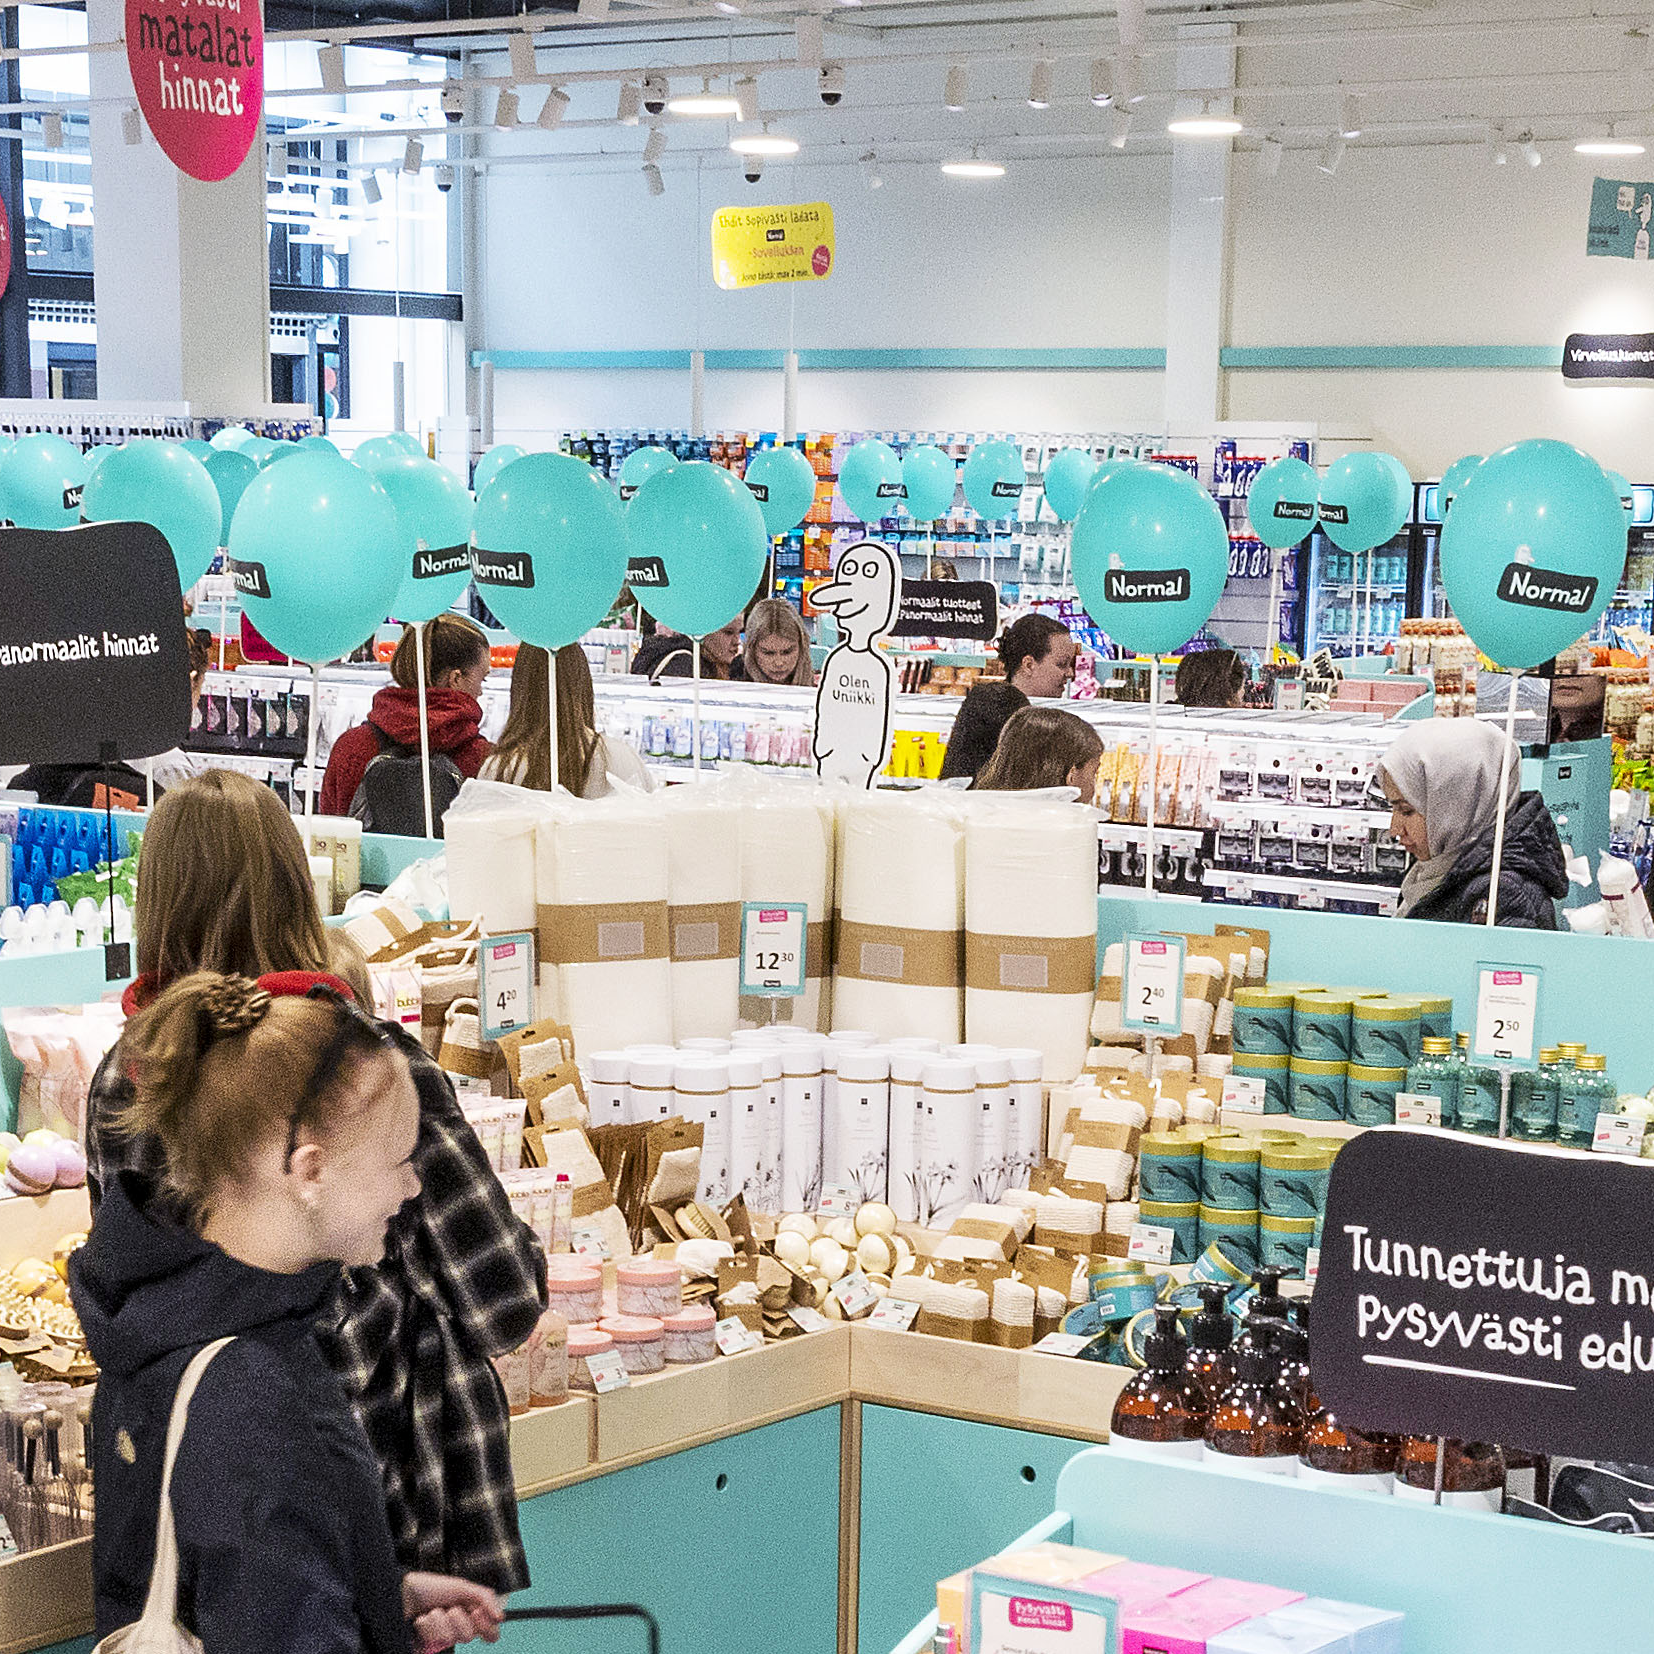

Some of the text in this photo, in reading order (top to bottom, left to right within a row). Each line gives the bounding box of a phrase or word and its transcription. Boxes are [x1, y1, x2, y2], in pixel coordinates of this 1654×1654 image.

[138, 12, 256, 68] matalat
[158, 60, 244, 116] hinnat
[1277, 503, 1313, 517] Normal
[1111, 574, 1183, 597] Normal
[1508, 571, 1591, 606] Normal
[104, 631, 160, 659] hinnat
[839, 674, 870, 688] Olen
[1344, 1225, 1596, 1307] Tunnettuja
